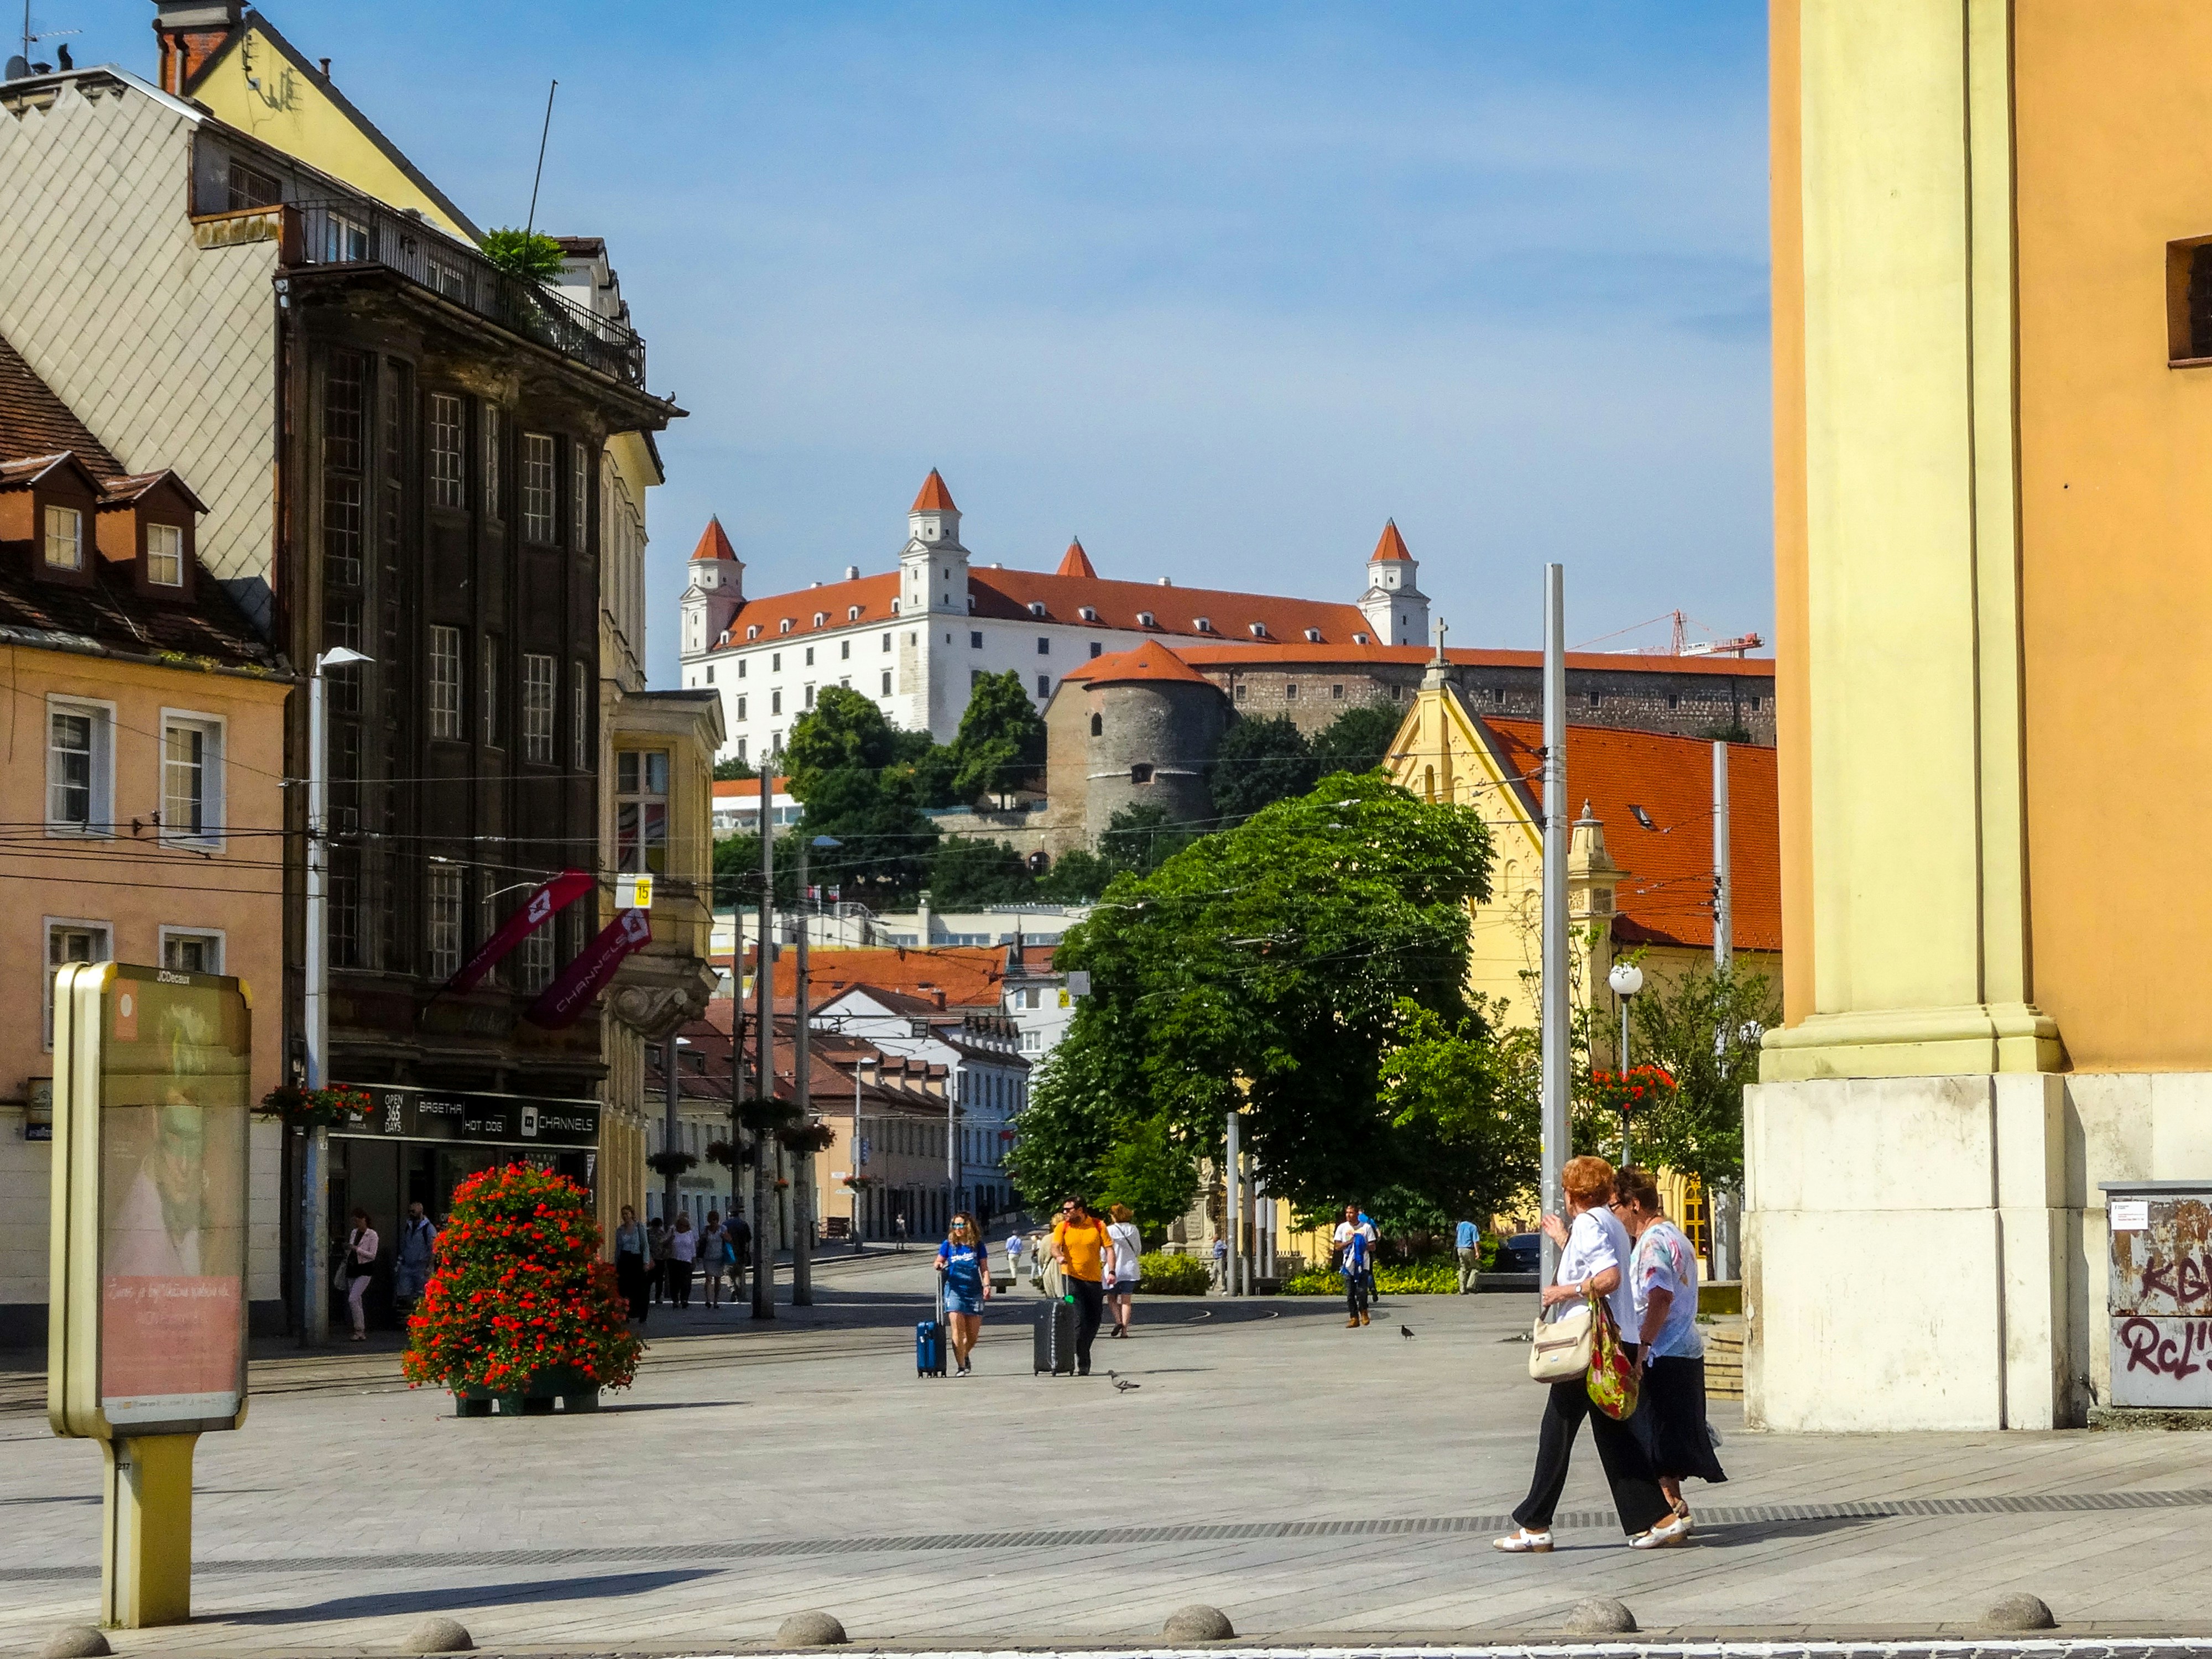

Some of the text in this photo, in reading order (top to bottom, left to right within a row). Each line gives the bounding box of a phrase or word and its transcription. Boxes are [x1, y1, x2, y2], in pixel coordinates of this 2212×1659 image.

[637, 886, 648, 899] 15
[156, 970, 190, 984] JCDecaux
[556, 933, 627, 1013] CHANNELS
[1060, 994, 1068, 1003] 20
[385, 1094, 403, 1105] OPEN
[387, 1105, 400, 1121] 365
[419, 1101, 462, 1114] BAGETHA
[385, 1121, 401, 1133] DAYS
[465, 1120, 503, 1131] HOT DOG
[539, 1116, 593, 1131] CHANNELS
